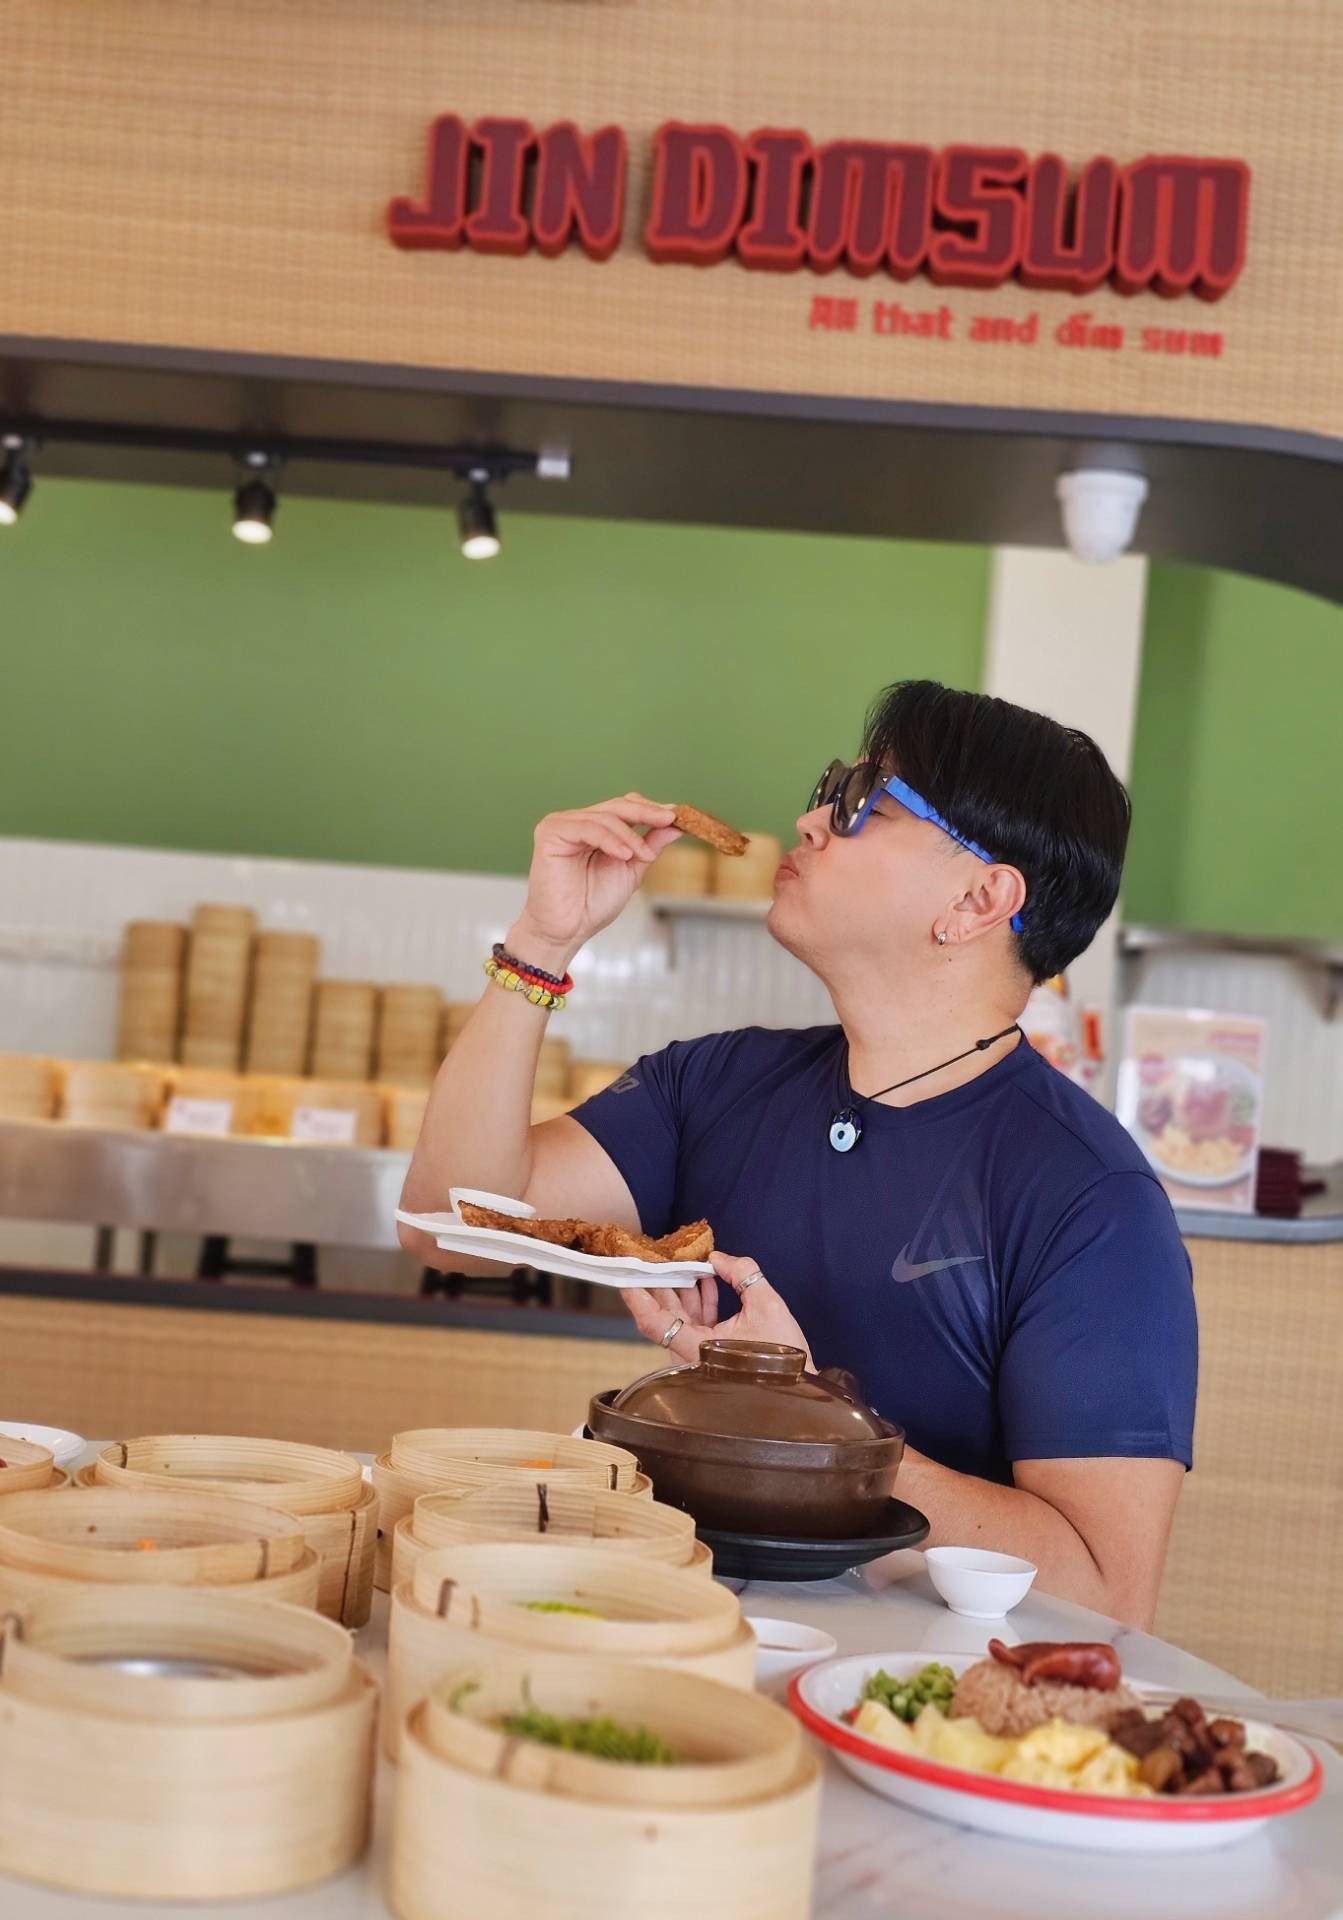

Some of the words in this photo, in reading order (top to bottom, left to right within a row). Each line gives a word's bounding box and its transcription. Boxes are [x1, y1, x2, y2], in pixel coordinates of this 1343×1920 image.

[386, 113, 628, 261] JIN
[644, 119, 1252, 300] DIMSUM
[809, 295, 859, 332] All
[873, 298, 953, 340] that
[969, 312, 1040, 344] and
[1056, 311, 1125, 350] dim
[1141, 327, 1223, 358] sum
